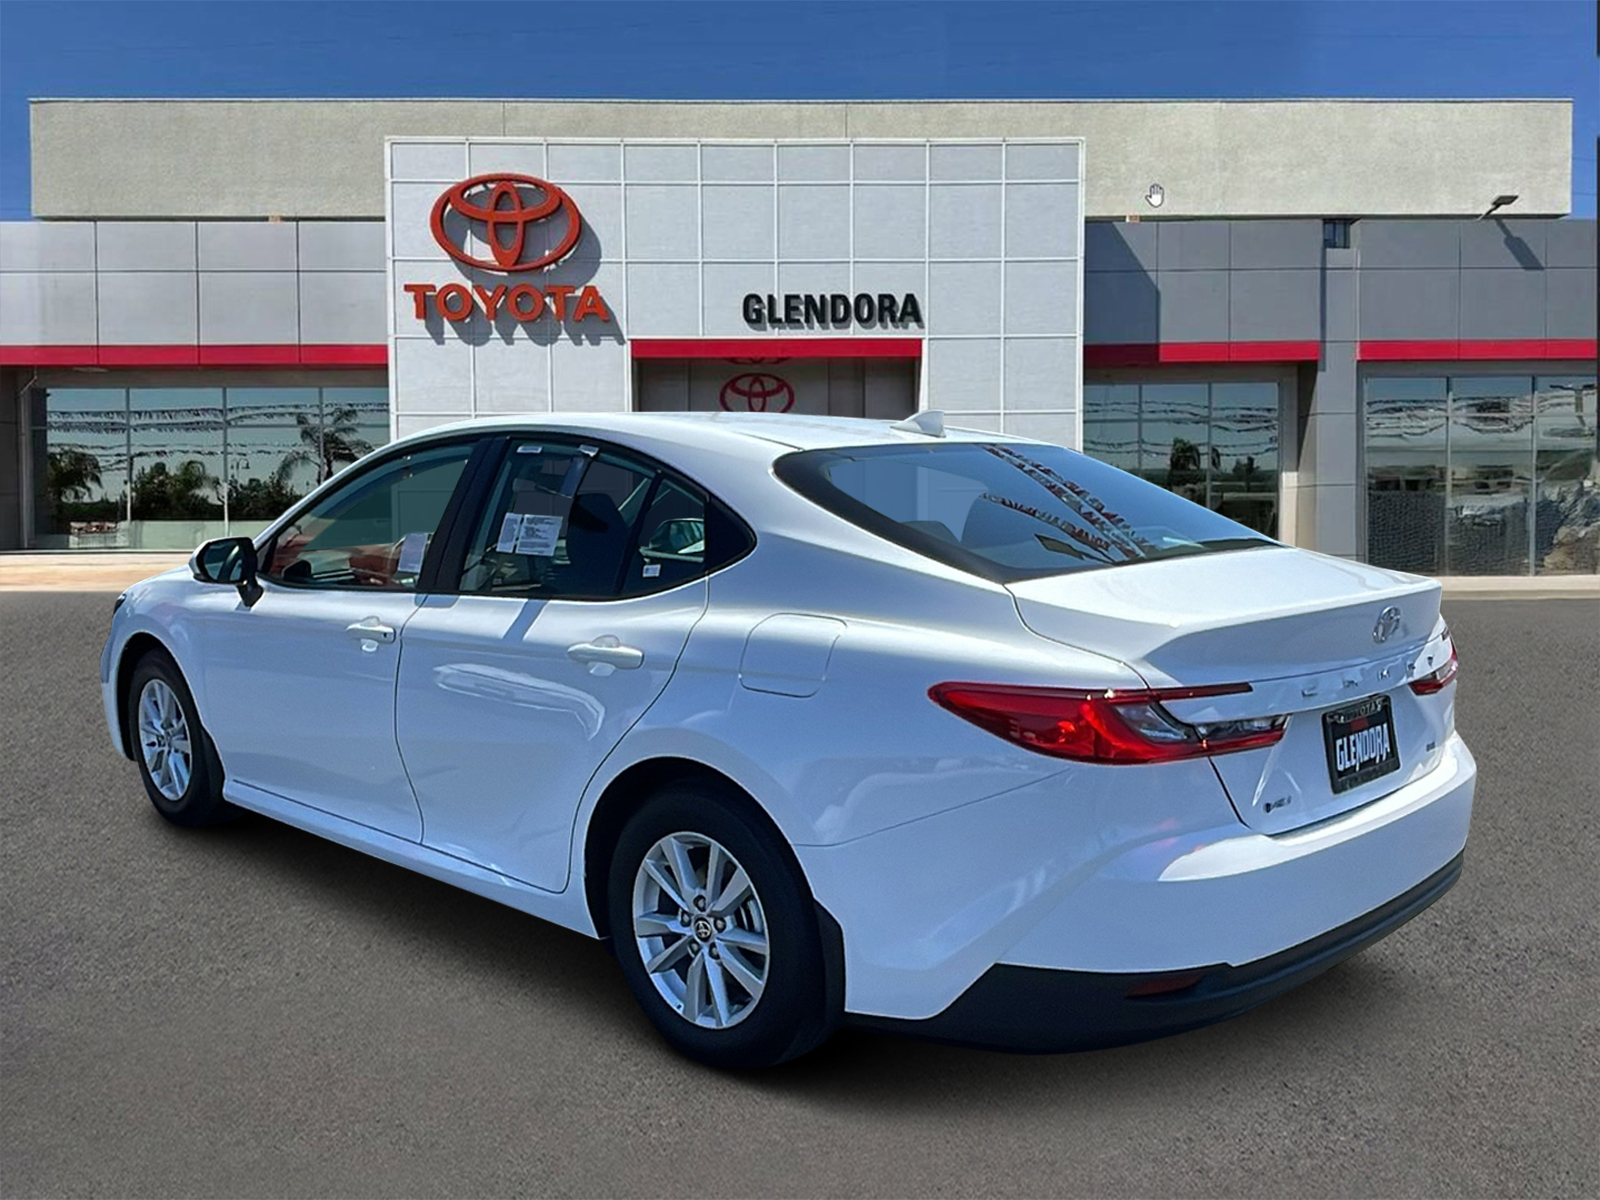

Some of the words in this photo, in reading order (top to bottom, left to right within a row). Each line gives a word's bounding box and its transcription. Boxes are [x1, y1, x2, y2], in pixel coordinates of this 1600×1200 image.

[404, 283, 610, 322] TOYOTA
[743, 293, 923, 324] GLENDORA
[1335, 722, 1390, 772] GLENDORA
